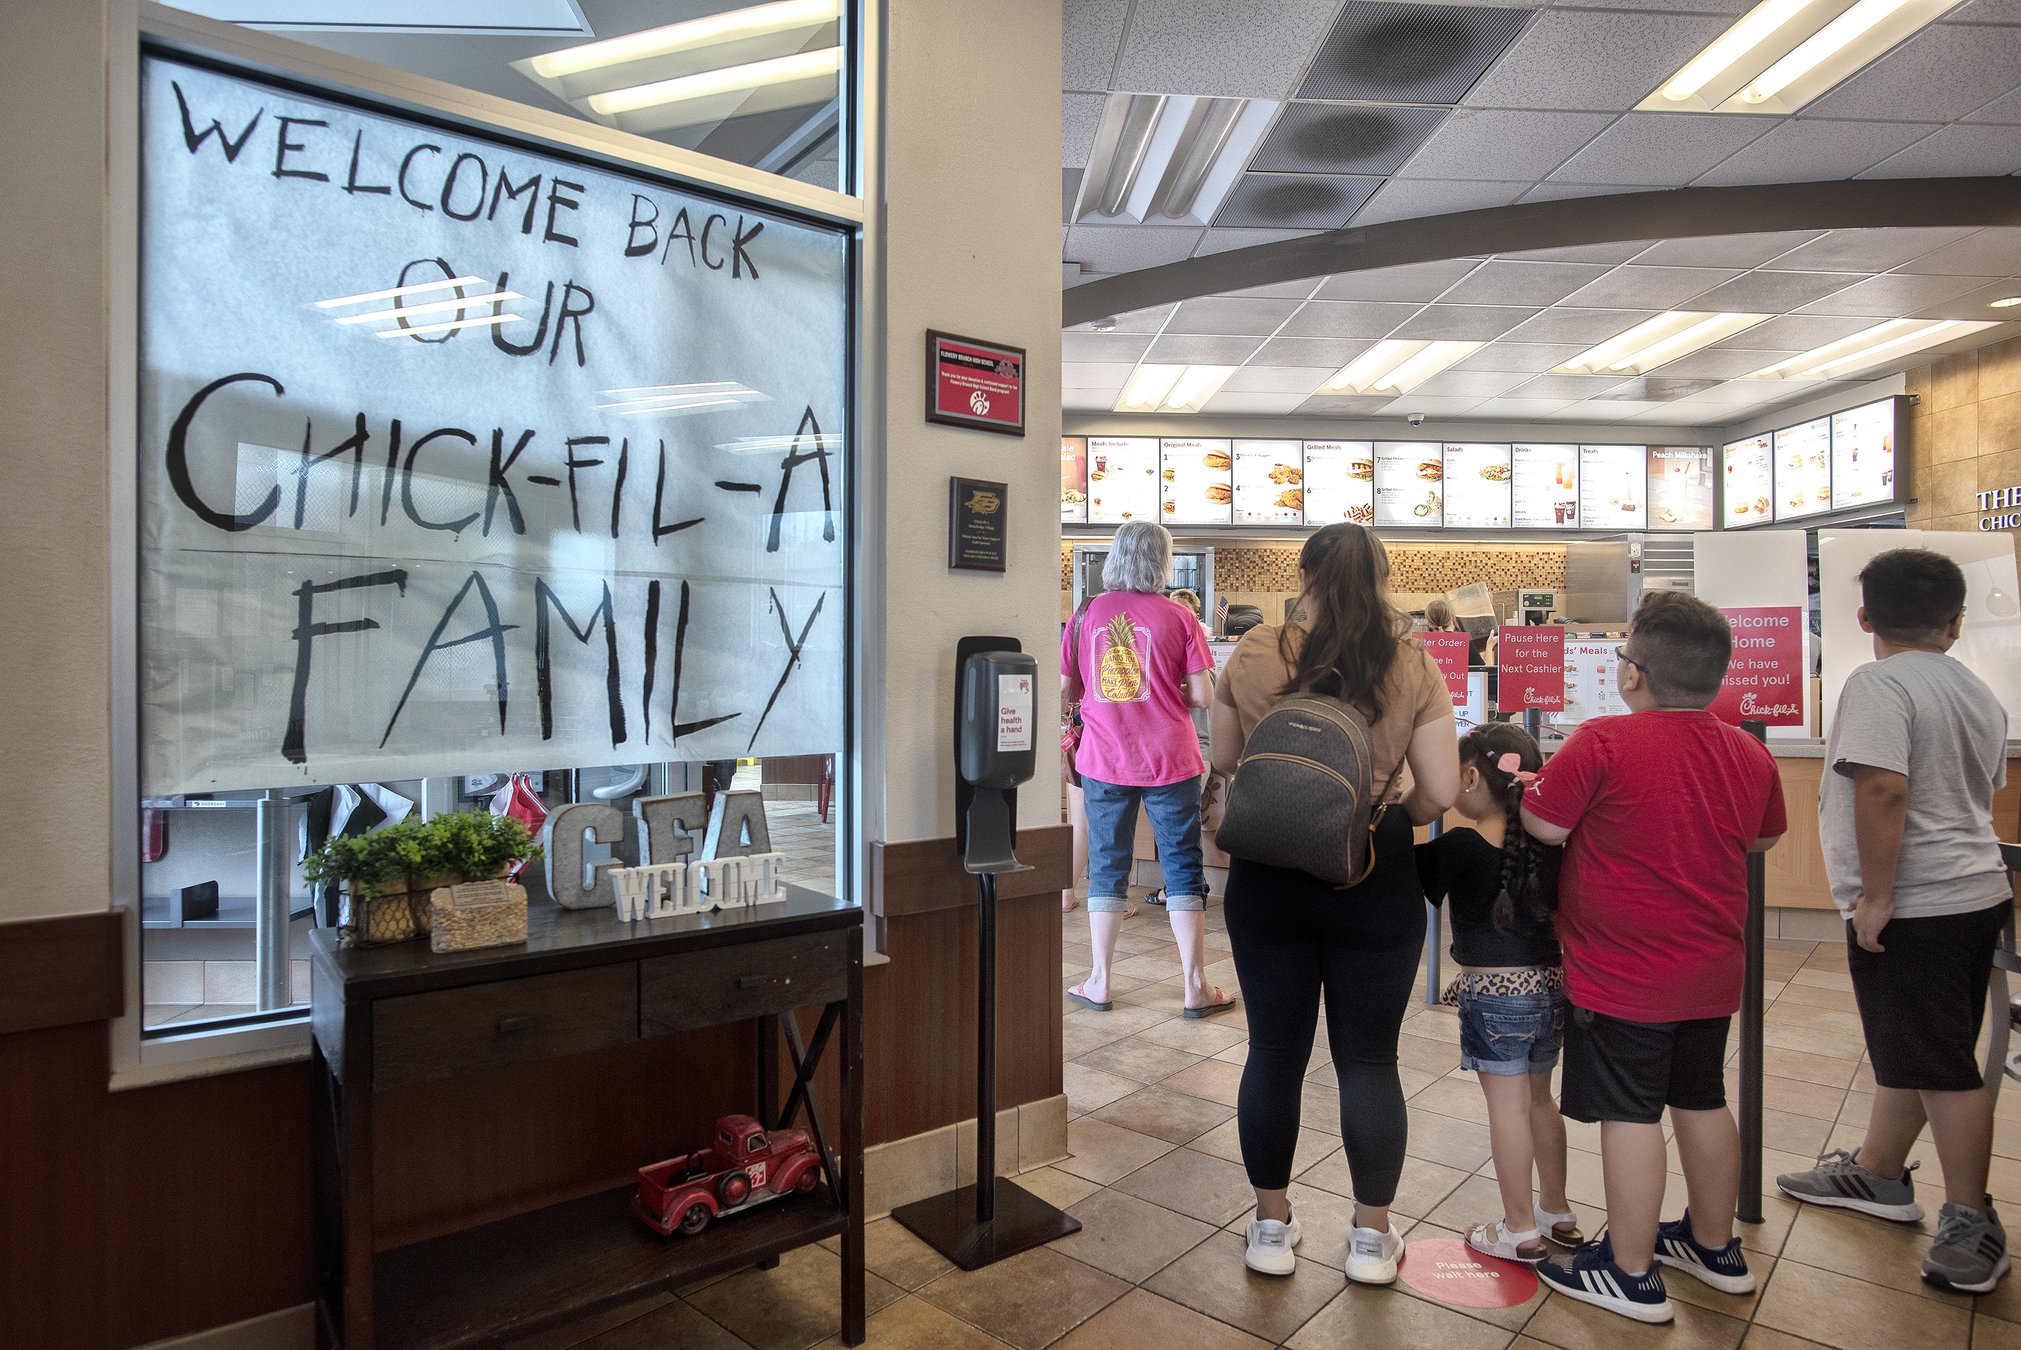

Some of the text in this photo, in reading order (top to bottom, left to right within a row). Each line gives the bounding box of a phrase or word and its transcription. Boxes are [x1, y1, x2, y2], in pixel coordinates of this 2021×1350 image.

[172, 81, 764, 279] WELCOME BACK
[395, 258, 595, 366] OUR
[1652, 451, 1708, 459] Peach Milkshake
[166, 372, 834, 552] CHICK-FIL-A
[1976, 486, 2021, 511] THE
[1726, 614, 1789, 628] elcome
[1423, 638, 1466, 647] ter Order:
[1505, 633, 1558, 643] Pause Here
[1515, 648, 1548, 658] for the
[1564, 646, 1608, 655] ds' Meals
[280, 569, 826, 764] FAMILY
[1501, 664, 1562, 673] Next Cashier
[1748, 658, 1779, 669] have
[1449, 672, 1465, 680] Out
[1762, 674, 1790, 688] you!
[1001, 707, 1016, 715] Give
[543, 789, 772, 909] CFA
[607, 851, 787, 922] WELCOME
[1435, 1261, 1483, 1270] Please
[1432, 1270, 1501, 1280] wait here
